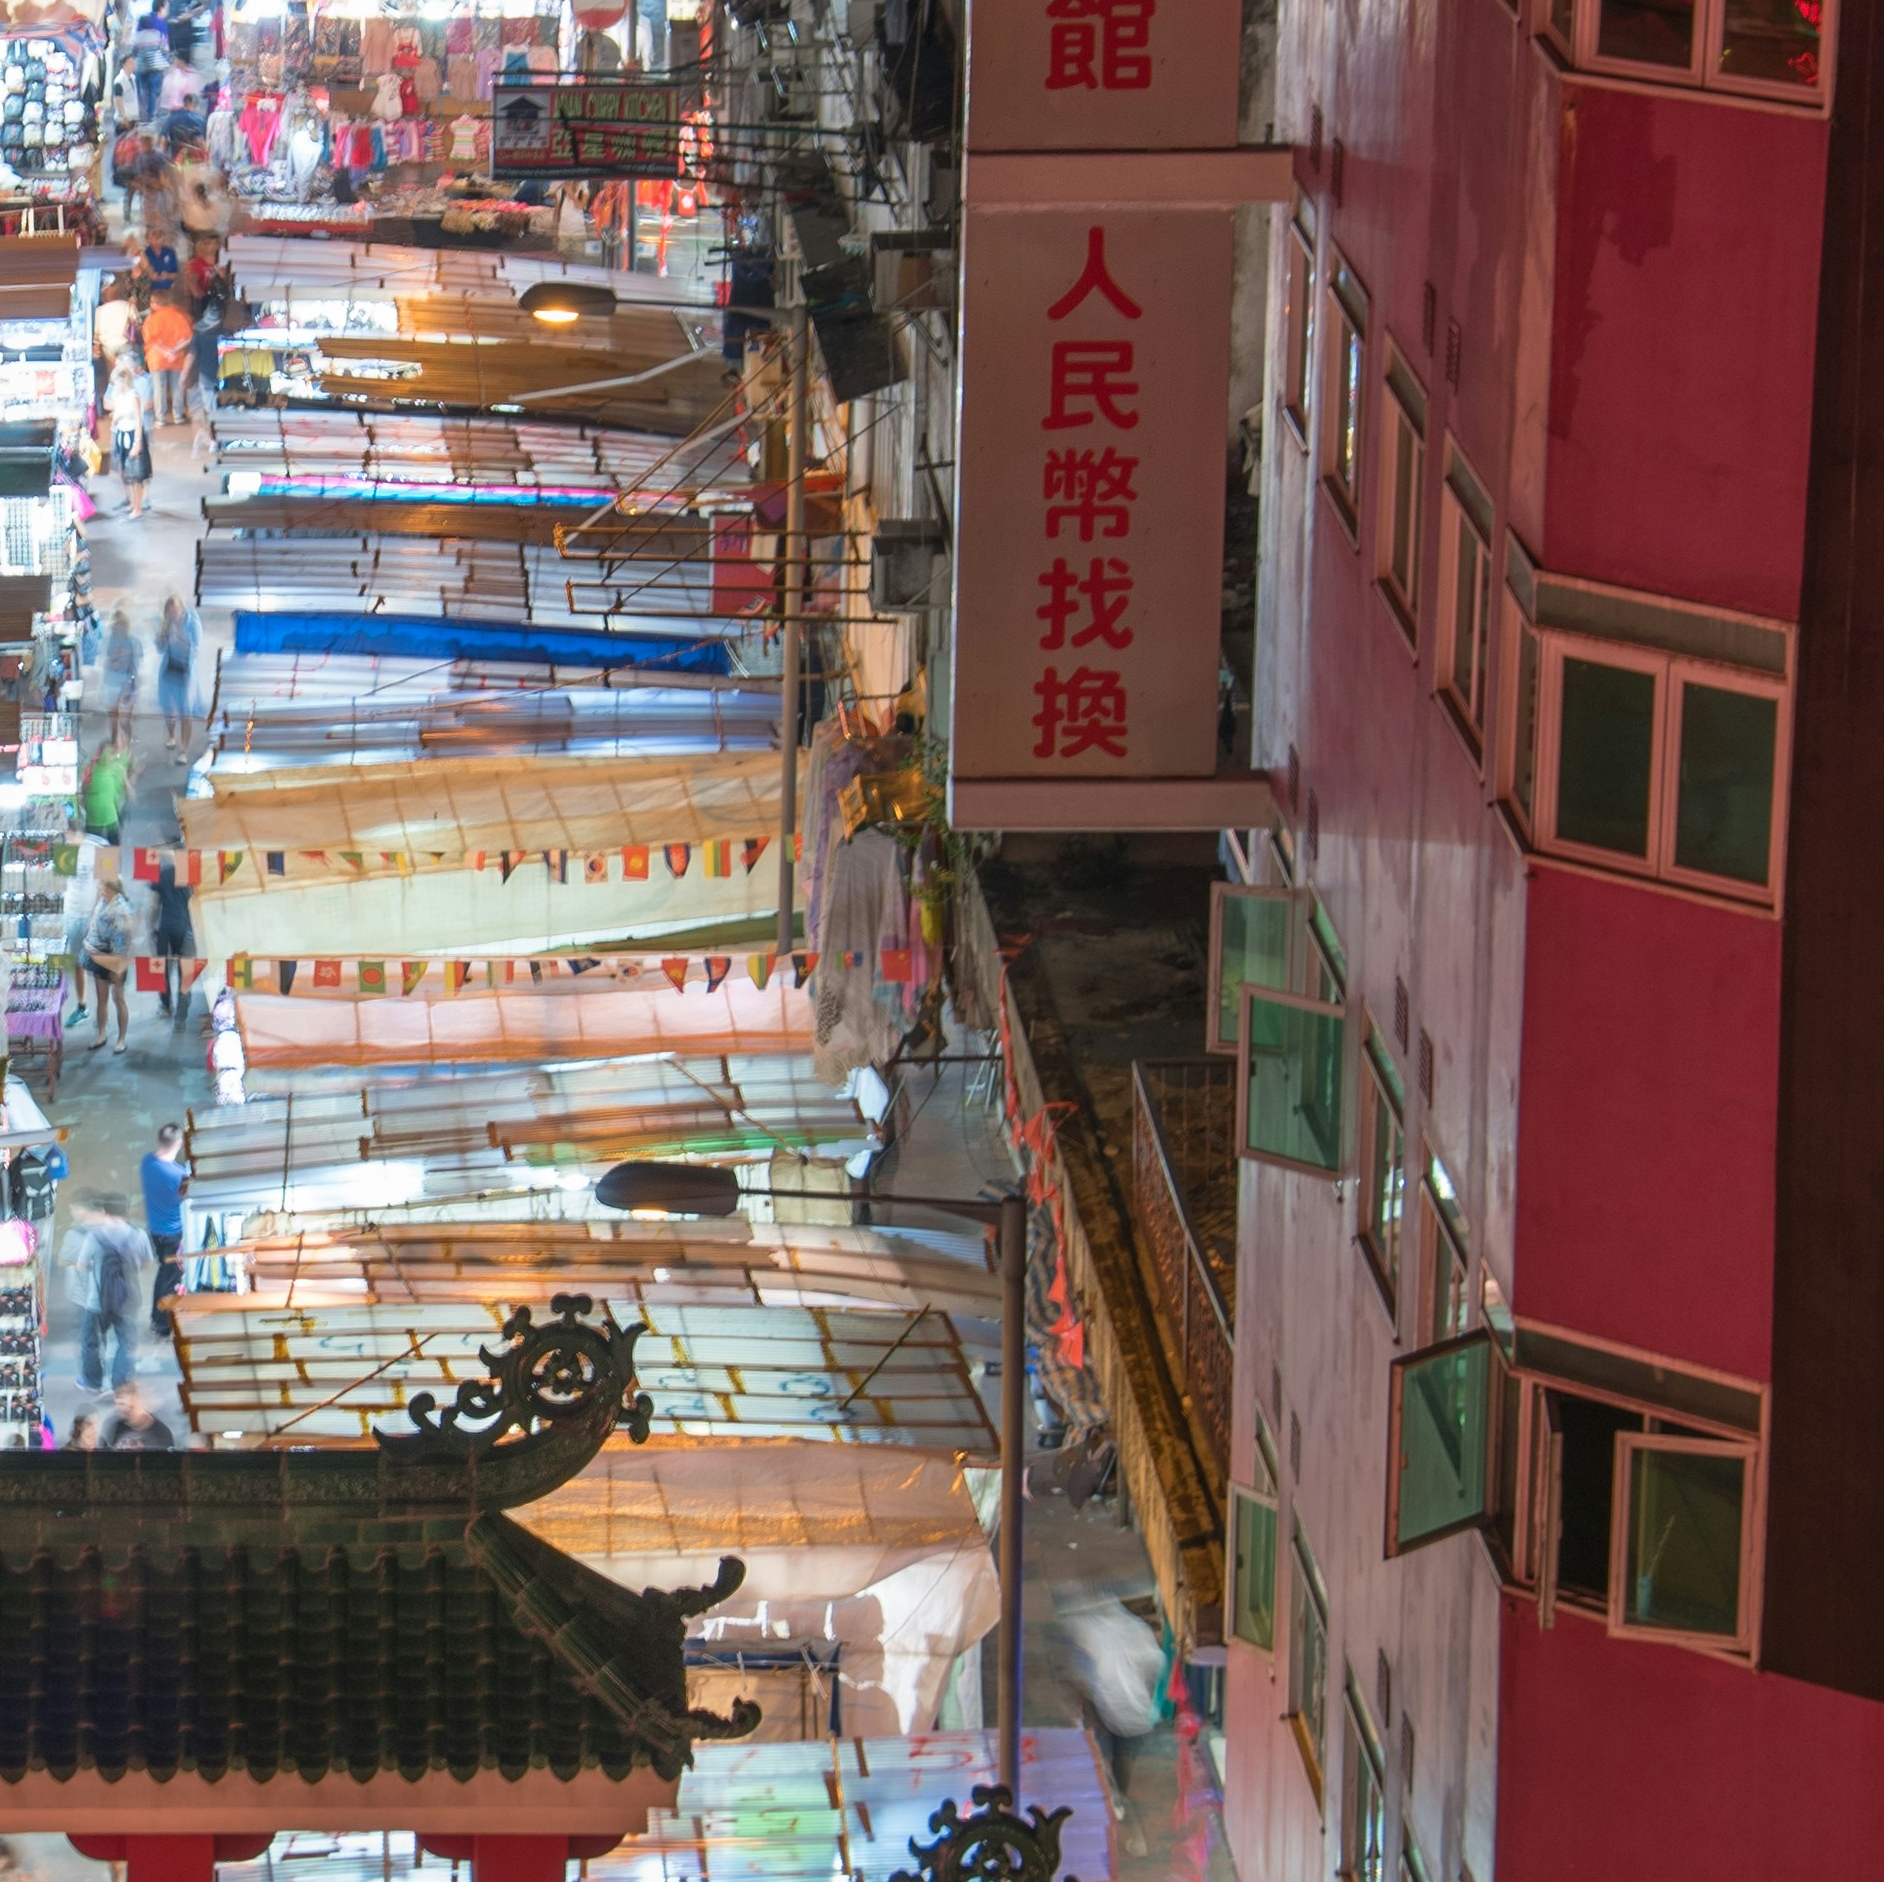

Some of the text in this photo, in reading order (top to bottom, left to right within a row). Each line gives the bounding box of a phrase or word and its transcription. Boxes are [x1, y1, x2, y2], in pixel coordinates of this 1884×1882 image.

[1031, 226, 1143, 758] 人民幣找換
